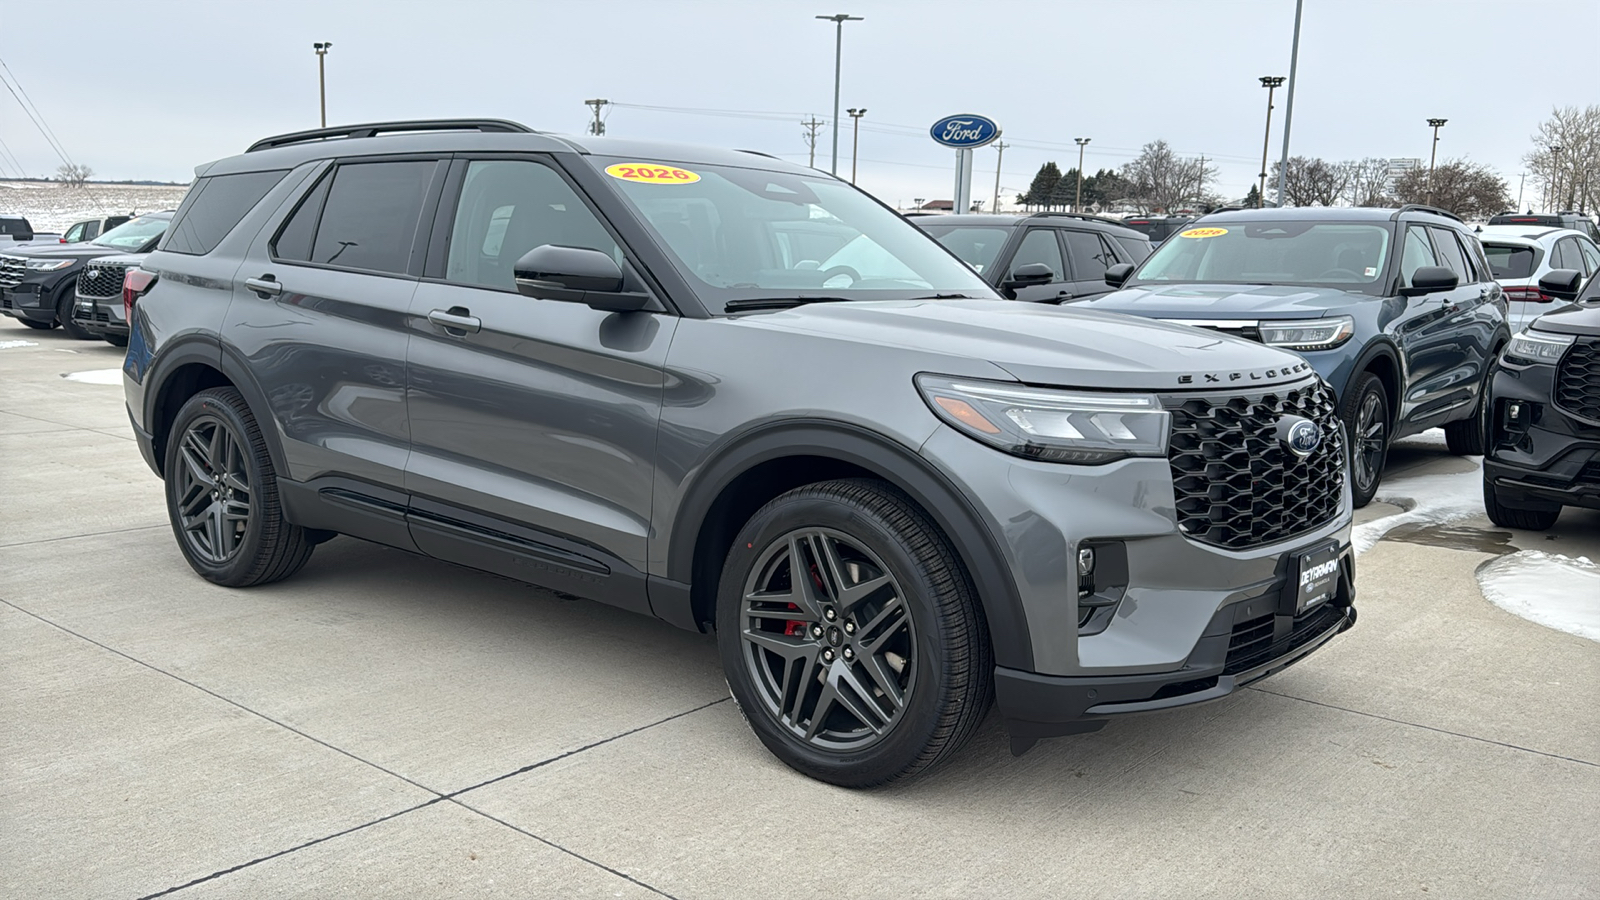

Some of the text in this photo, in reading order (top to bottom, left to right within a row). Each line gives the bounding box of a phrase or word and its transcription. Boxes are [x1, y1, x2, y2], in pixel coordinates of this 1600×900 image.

[942, 120, 983, 141] Ford
[618, 167, 690, 180] 2026
[1177, 362, 1309, 384] EXPLORER
